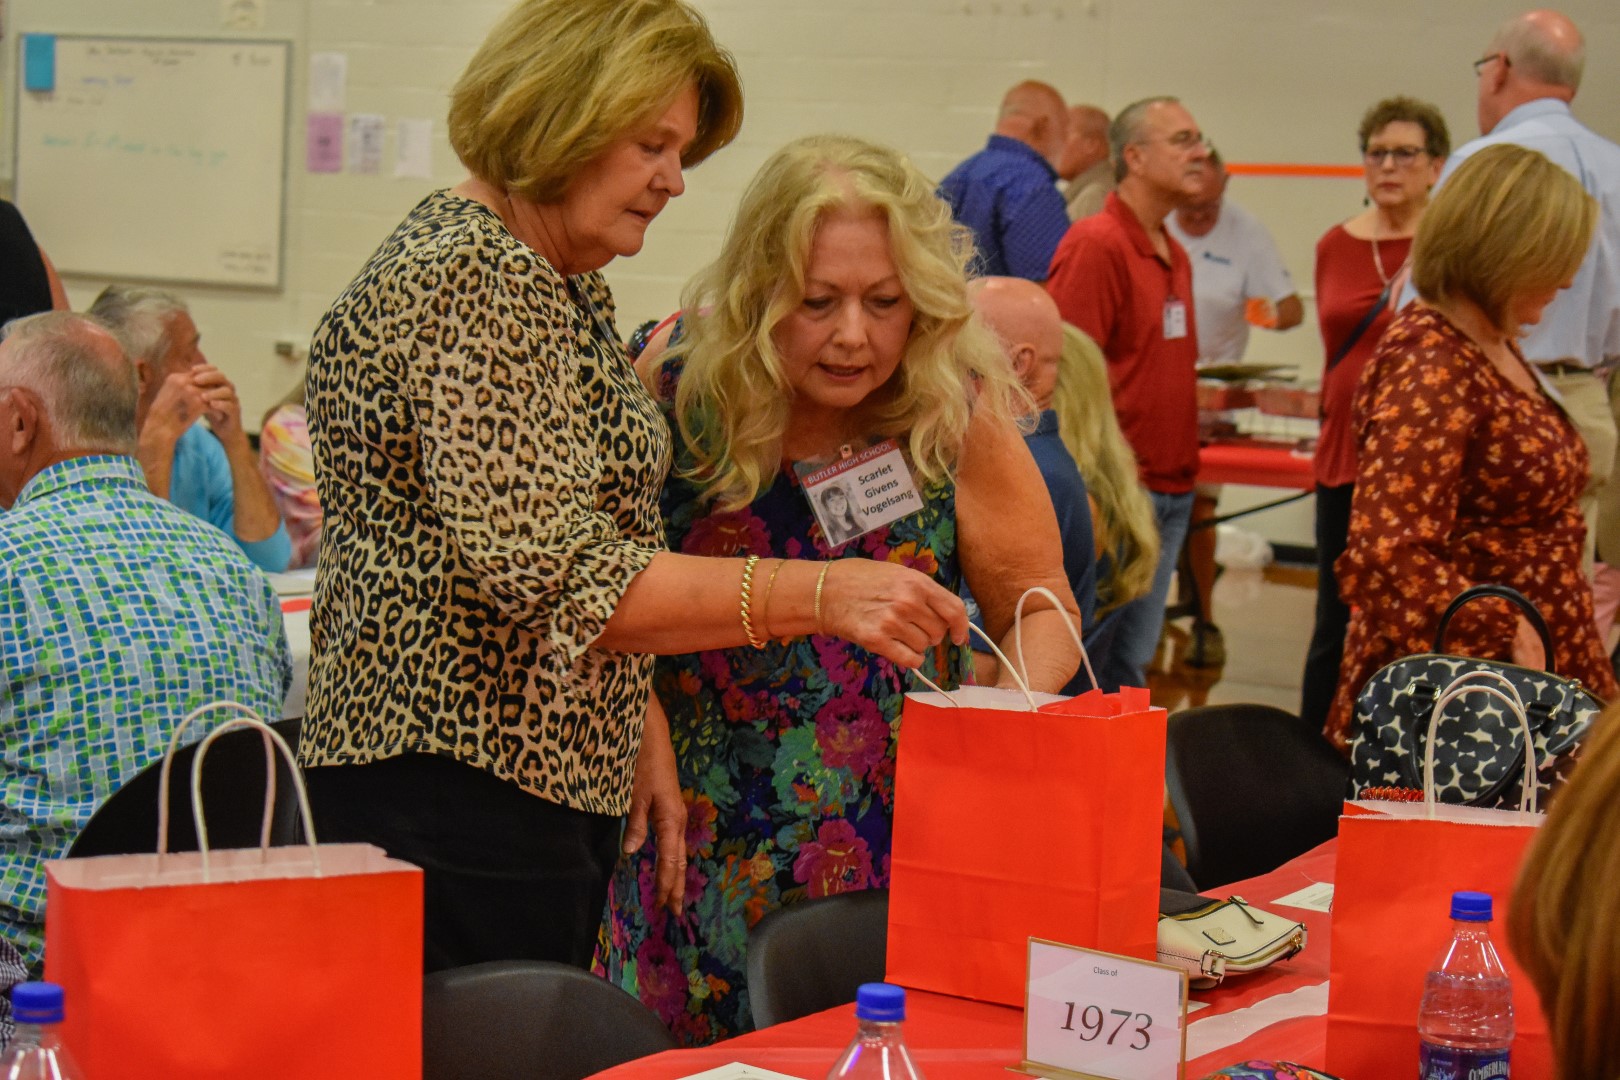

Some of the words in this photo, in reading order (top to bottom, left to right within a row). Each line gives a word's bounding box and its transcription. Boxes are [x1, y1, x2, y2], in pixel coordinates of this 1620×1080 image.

[807, 465, 838, 484] BUTLER
[838, 456, 860, 472] HIGH
[860, 442, 892, 461] SCHOOL
[858, 463, 894, 486] Scarlet
[864, 478, 899, 499] Givens
[861, 489, 914, 516] Vogelsang
[1093, 966, 1110, 976] Class
[1110, 969, 1118, 977] of
[1060, 1001, 1153, 1051] 1973
